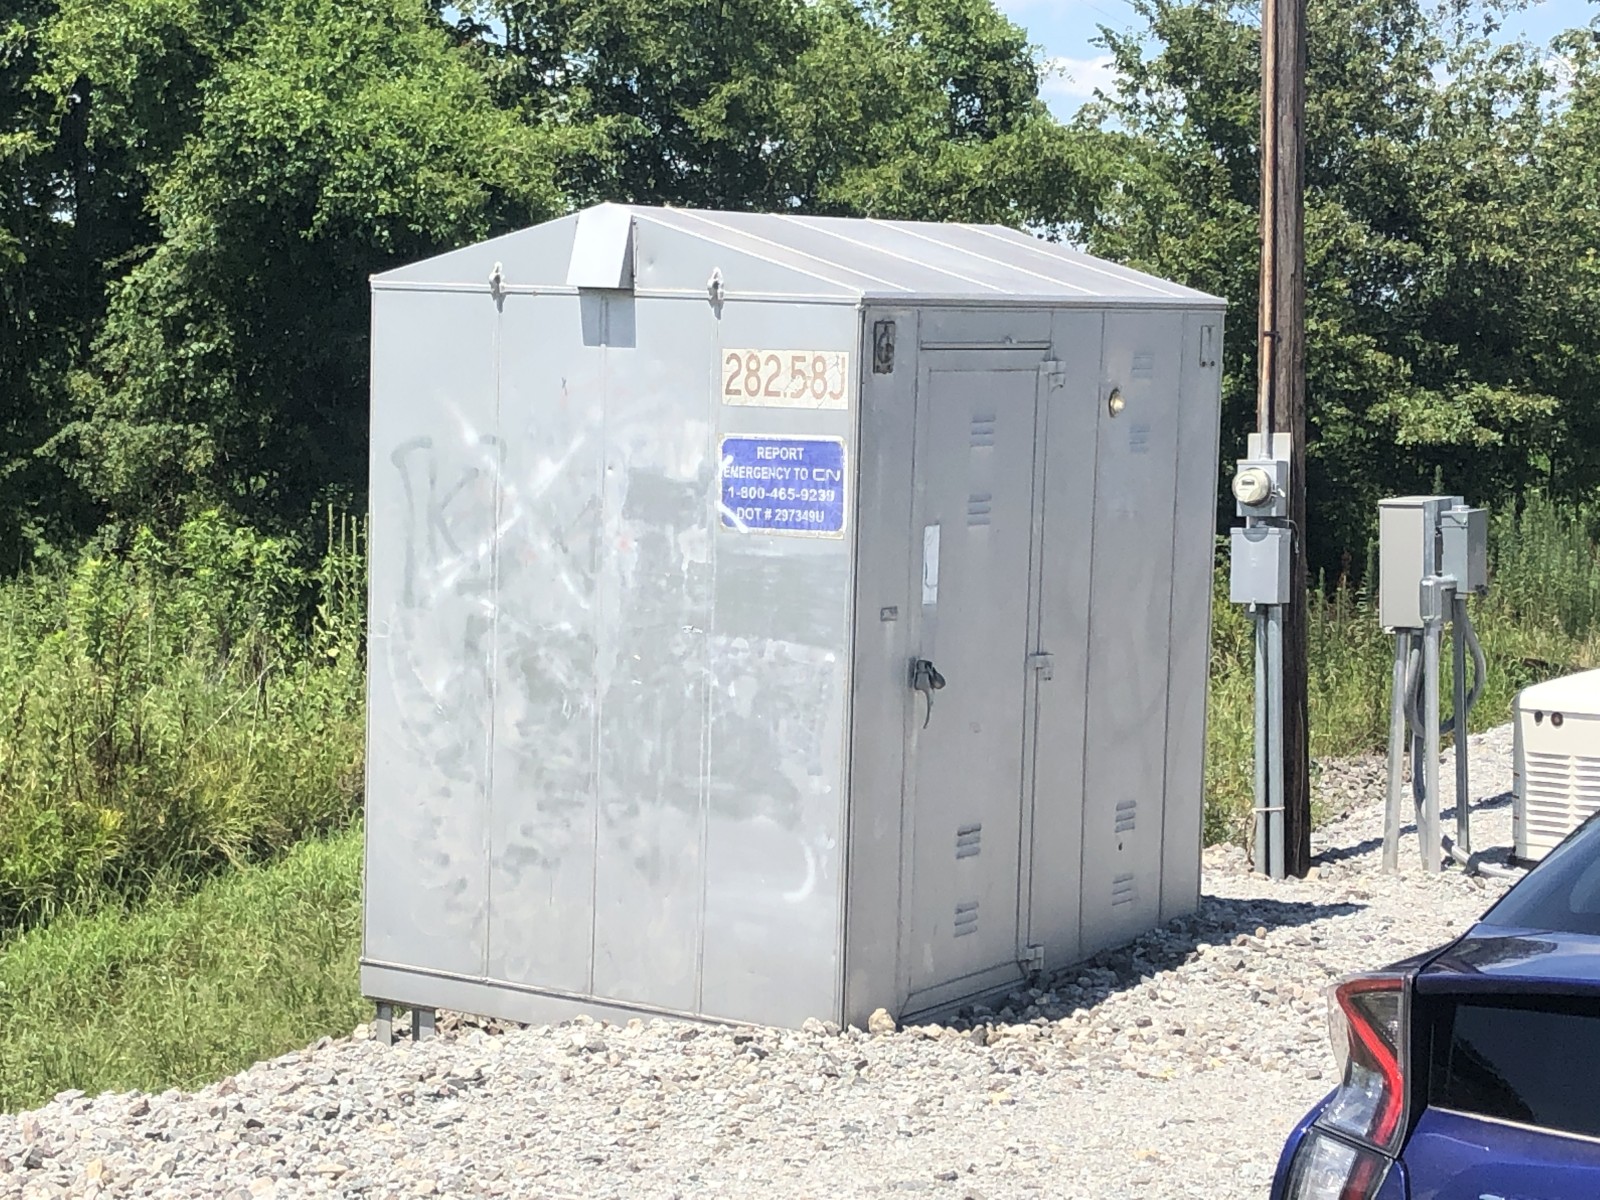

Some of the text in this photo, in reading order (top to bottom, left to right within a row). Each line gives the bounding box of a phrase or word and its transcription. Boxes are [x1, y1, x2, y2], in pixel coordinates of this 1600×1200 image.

[756, 446, 804, 460] REPORT
[723, 465, 840, 481] EMERGENCY TO CN
[736, 506, 824, 522] DOT # 297349U
